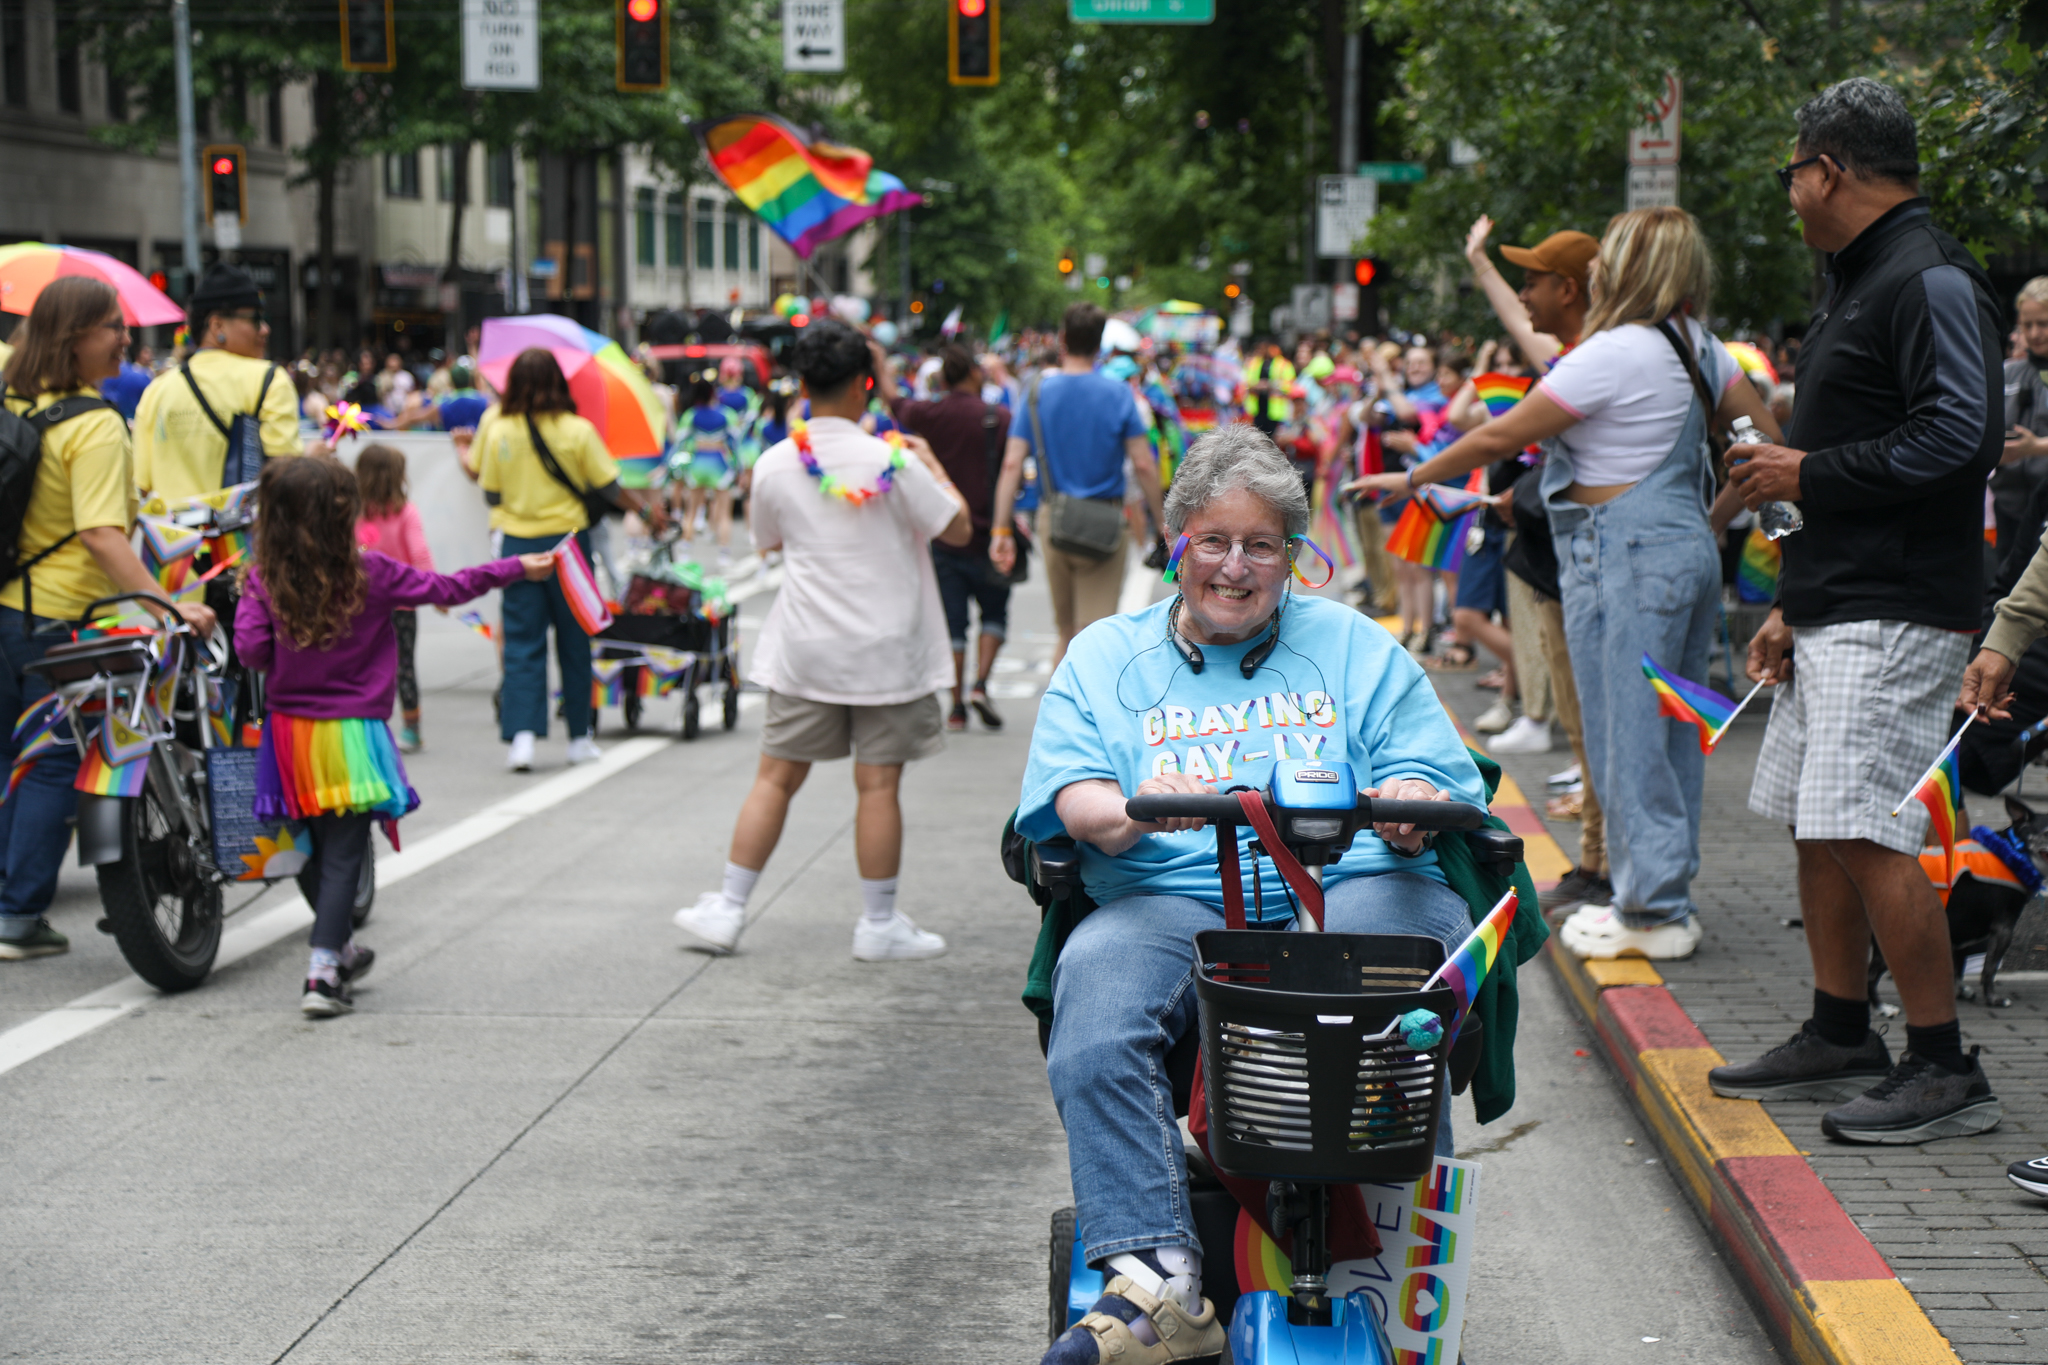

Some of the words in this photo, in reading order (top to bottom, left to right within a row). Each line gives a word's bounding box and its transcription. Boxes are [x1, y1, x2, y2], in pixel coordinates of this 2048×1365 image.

[793, 3, 830, 18] ONE
[479, 22, 524, 37] TURN
[794, 22, 833, 38] WAY
[489, 42, 514, 56] ON
[484, 62, 518, 77] RED
[1143, 690, 1338, 747] GRAYING
[1298, 771, 1337, 779] PRIDE
[1349, 1182, 1404, 1327] OVE
[1393, 1164, 1466, 1365] LOVE
